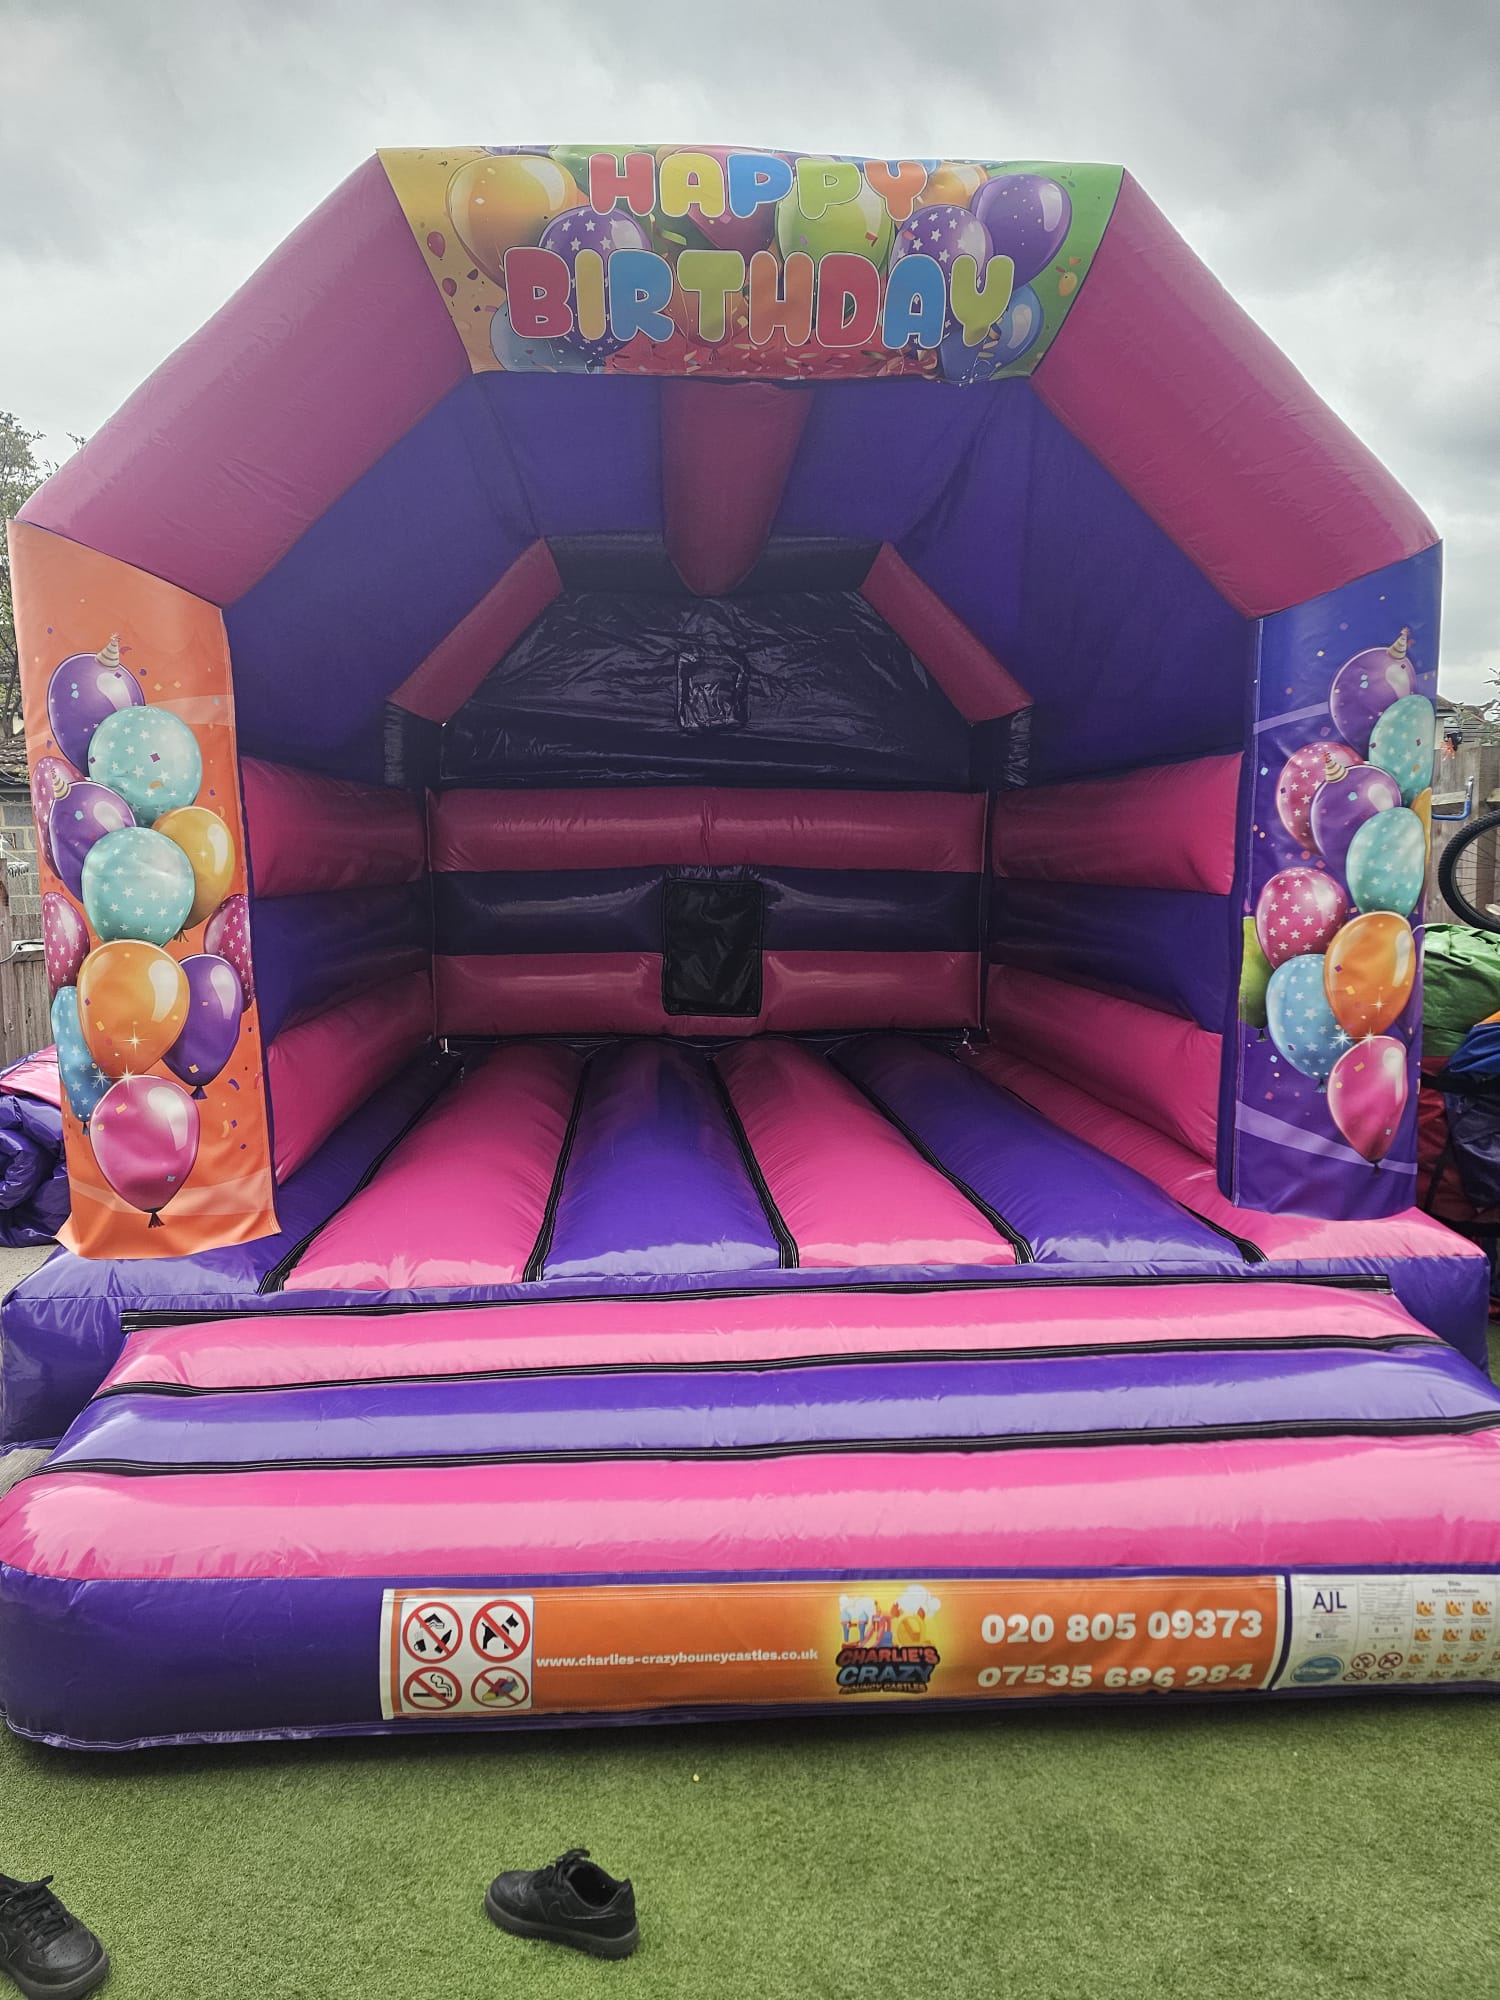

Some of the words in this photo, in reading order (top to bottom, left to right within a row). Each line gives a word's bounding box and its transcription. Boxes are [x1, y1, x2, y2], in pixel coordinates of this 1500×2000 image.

[589, 153, 928, 219] HAPPY
[503, 245, 1016, 351] BIRTHDAY
[1312, 1591, 1348, 1613] AJL
[980, 1613, 1055, 1644] 020
[1065, 1612, 1137, 1642] 805
[1147, 1609, 1263, 1640] 09373
[535, 1648, 819, 1668] www.charlies-crazybouncycastles.co.uk
[837, 1647, 938, 1665] CHARLIE'S
[838, 1664, 933, 1684] CRAZY
[977, 1664, 1093, 1688] 07535
[1184, 1663, 1254, 1687] 284
